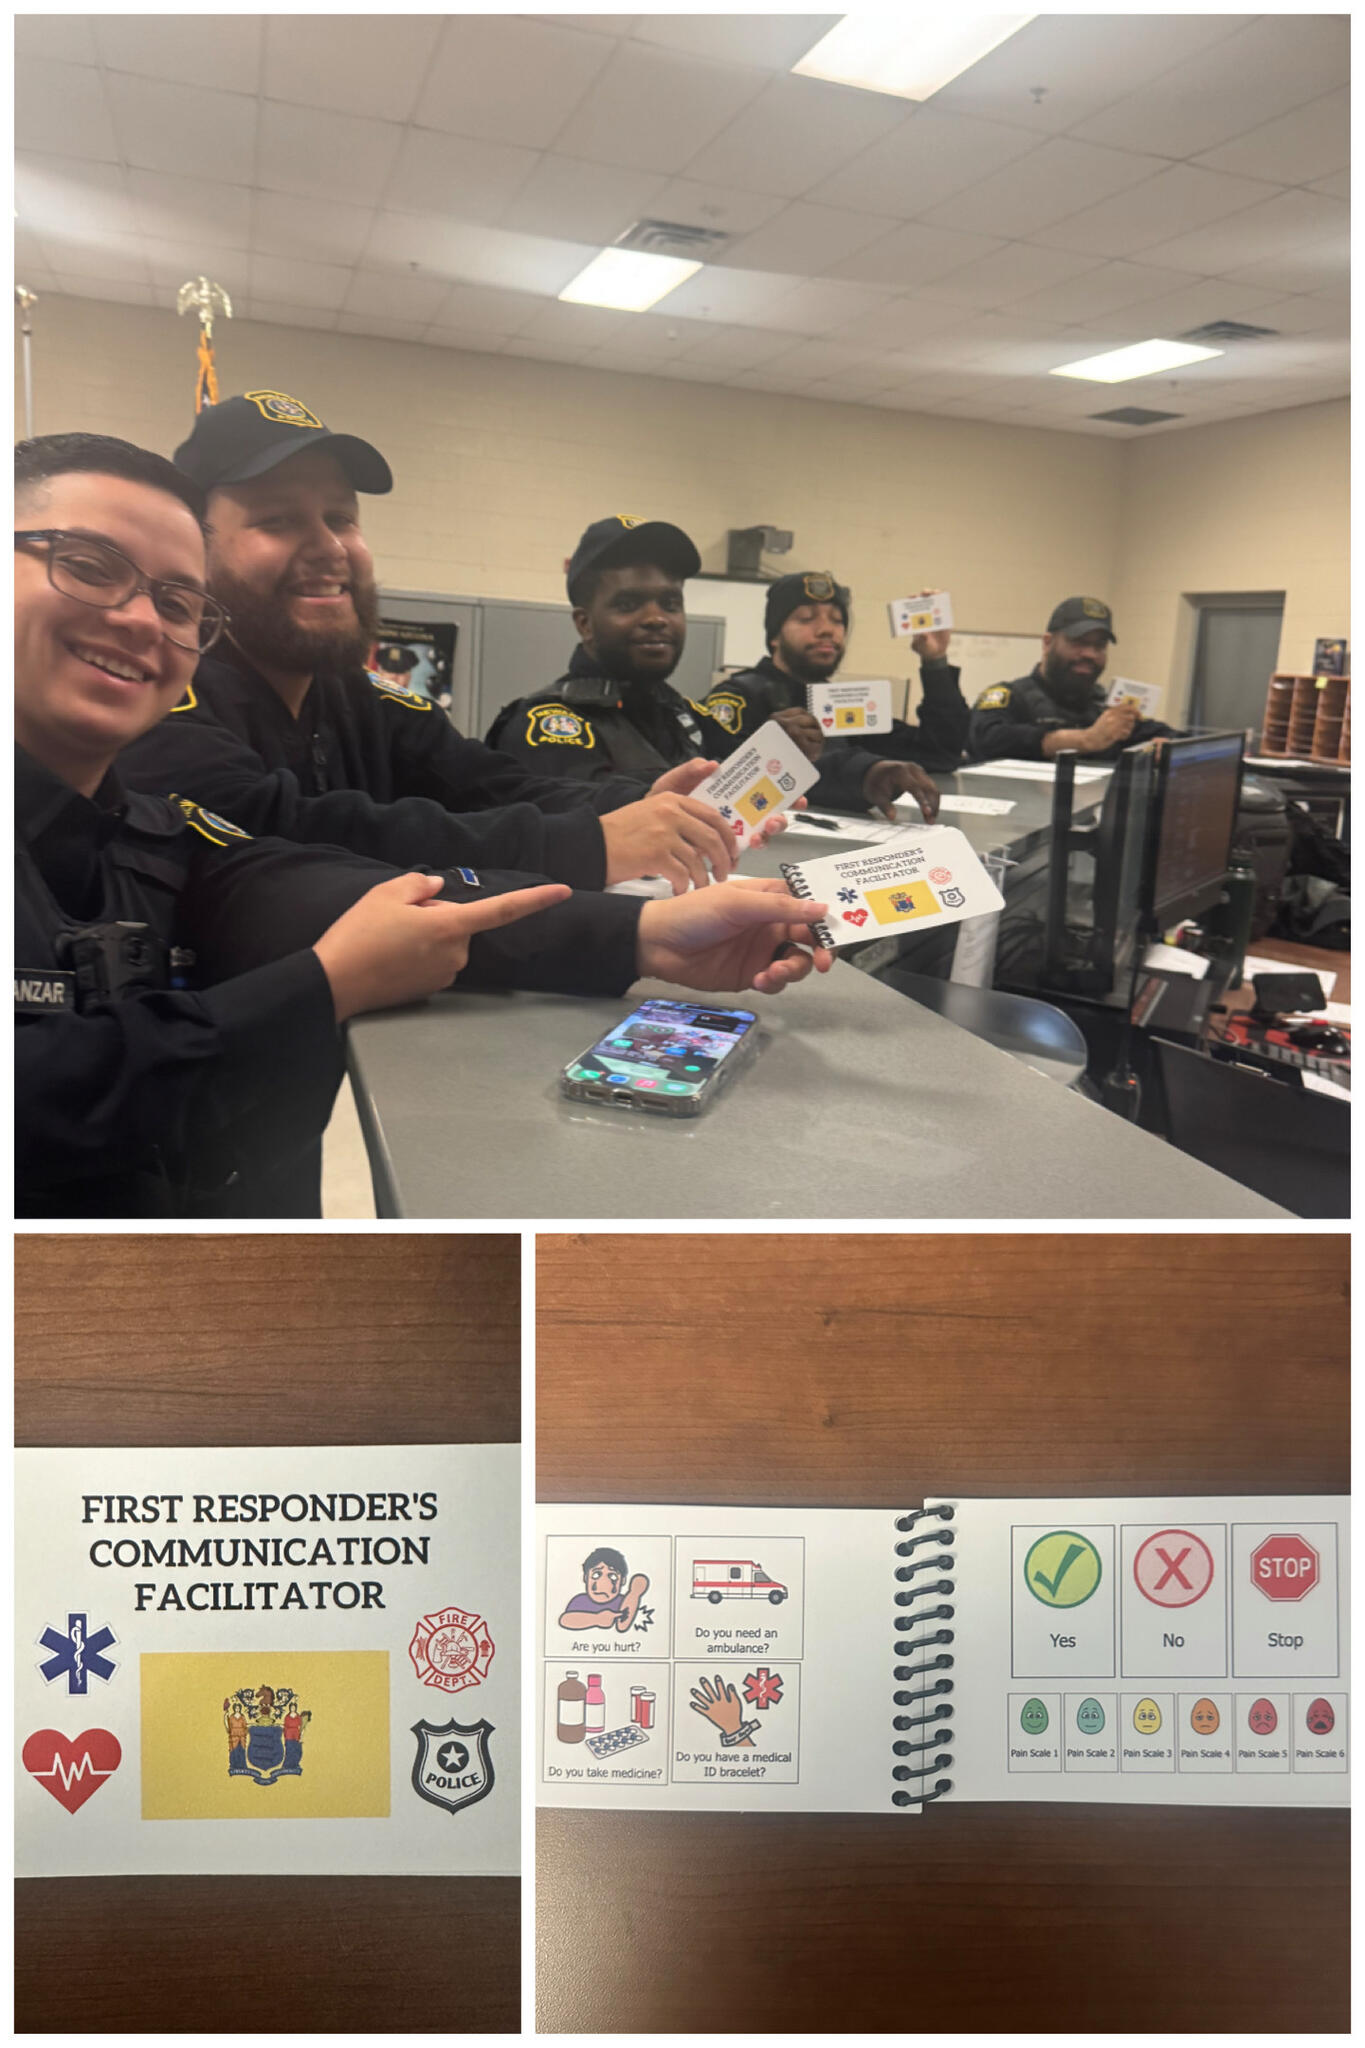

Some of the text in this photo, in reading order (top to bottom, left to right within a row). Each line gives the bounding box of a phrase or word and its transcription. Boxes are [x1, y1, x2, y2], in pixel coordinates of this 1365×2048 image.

[538, 735, 585, 746] POLICE
[834, 861, 860, 871] FIRST
[840, 856, 926, 878] COMMUNICATION
[855, 867, 920, 885] FACILITATOR
[81, 1492, 438, 1524] FIRST RESPONDER'S
[89, 1536, 431, 1568] COMMUNICATION
[1258, 1557, 1312, 1579] STOP
[134, 1580, 386, 1612] FACILITATOR
[438, 1613, 470, 1625] FIRE
[695, 1627, 778, 1640] Do you need an
[1050, 1633, 1076, 1648] Yes
[1163, 1633, 1185, 1648] No
[1267, 1632, 1304, 1650] Stop
[572, 1642, 641, 1654] Are you hurt?
[707, 1643, 770, 1653] ambulance?
[433, 1675, 472, 1687] DEPT.
[676, 1752, 792, 1764] Do you have a medical
[1011, 1749, 1027, 1758] Pain
[1030, 1749, 1050, 1758] Scale
[1067, 1749, 1084, 1758] Pain
[1086, 1749, 1108, 1758] Scale
[1123, 1749, 1140, 1758] Pain
[1143, 1749, 1164, 1758] Scale
[1181, 1749, 1198, 1758] Pain
[1200, 1749, 1222, 1758] Scale
[1238, 1749, 1255, 1758] Pain
[1258, 1749, 1280, 1758] Scale
[1296, 1749, 1313, 1758] Pain
[1315, 1749, 1337, 1758] Scale
[548, 1766, 662, 1779] Do you take medicine?
[704, 1766, 766, 1777] ID bracelet?
[425, 1772, 482, 1789] POLICE
